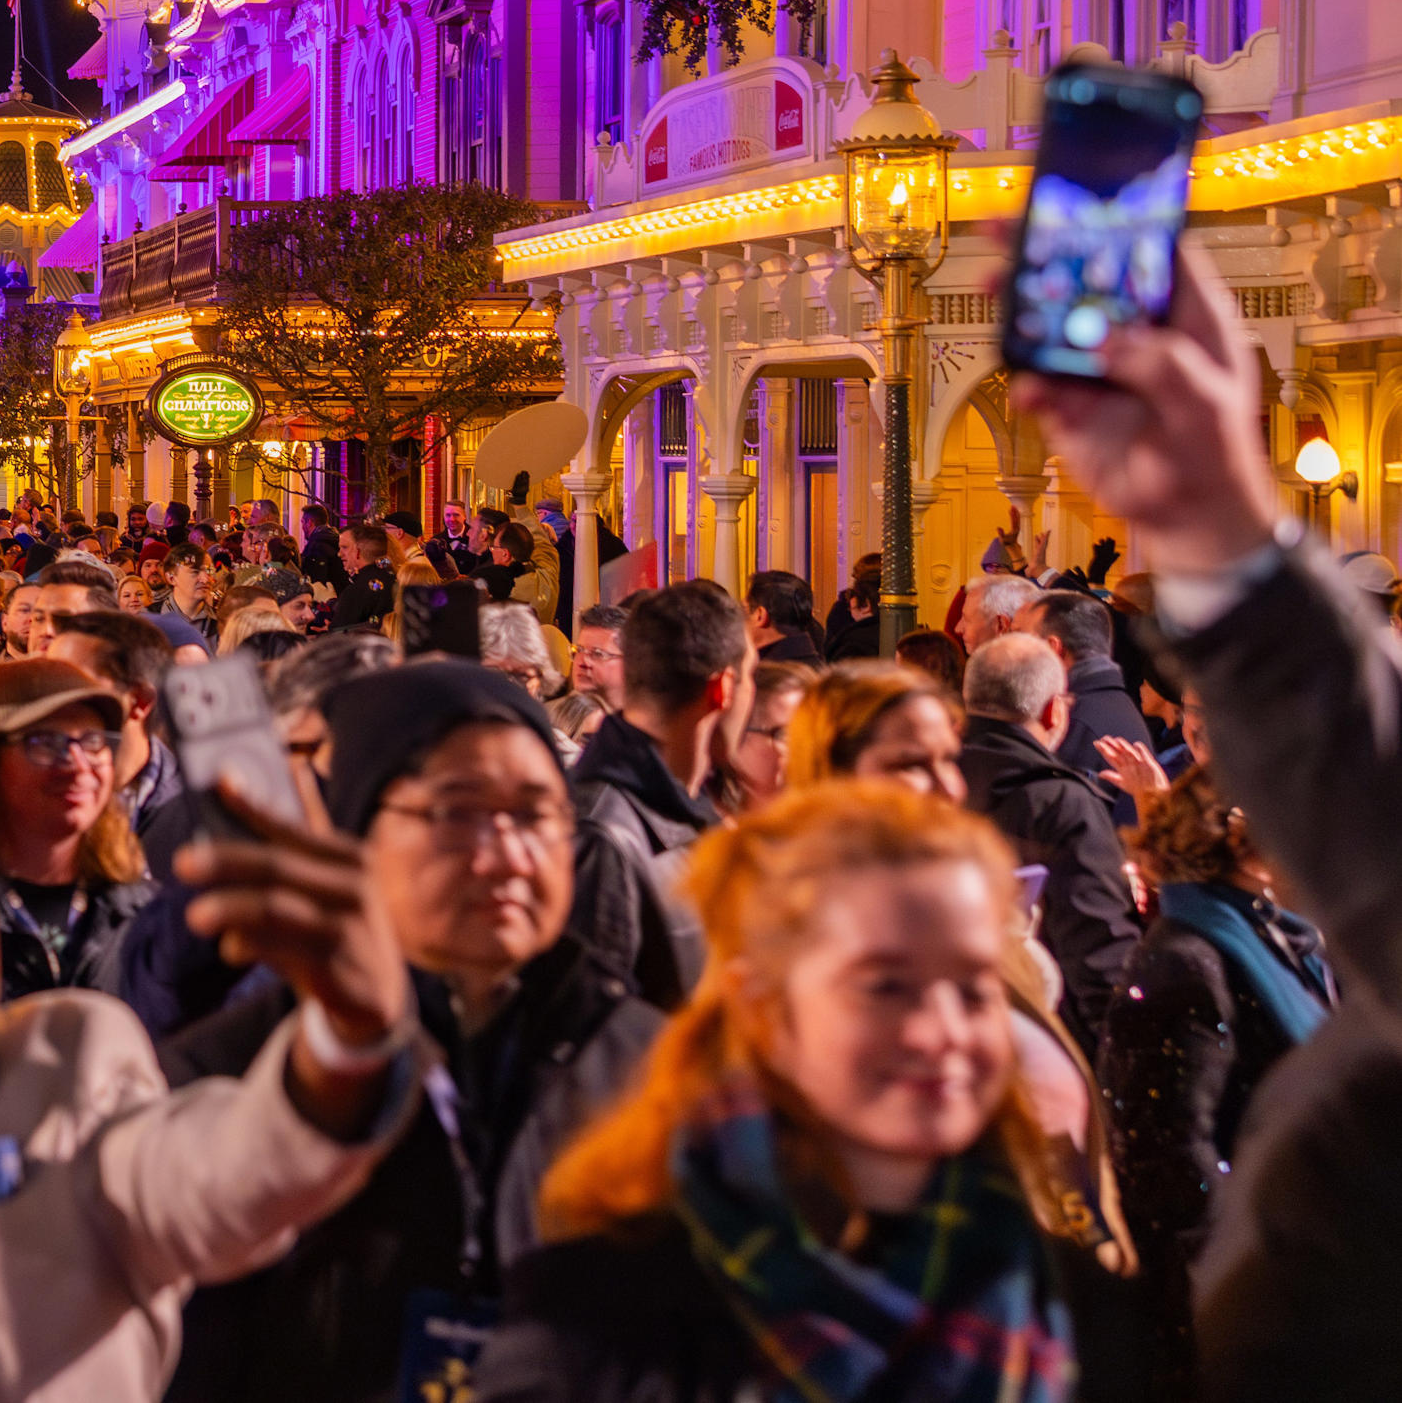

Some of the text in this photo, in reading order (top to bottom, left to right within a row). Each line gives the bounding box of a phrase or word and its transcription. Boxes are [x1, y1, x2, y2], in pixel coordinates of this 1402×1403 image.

[689, 144, 716, 174] FAMOUS
[718, 140, 731, 165] HOT
[732, 140, 750, 161] DOGS
[188, 381, 226, 393] HALL
[164, 400, 249, 412] CHAMPIONS
